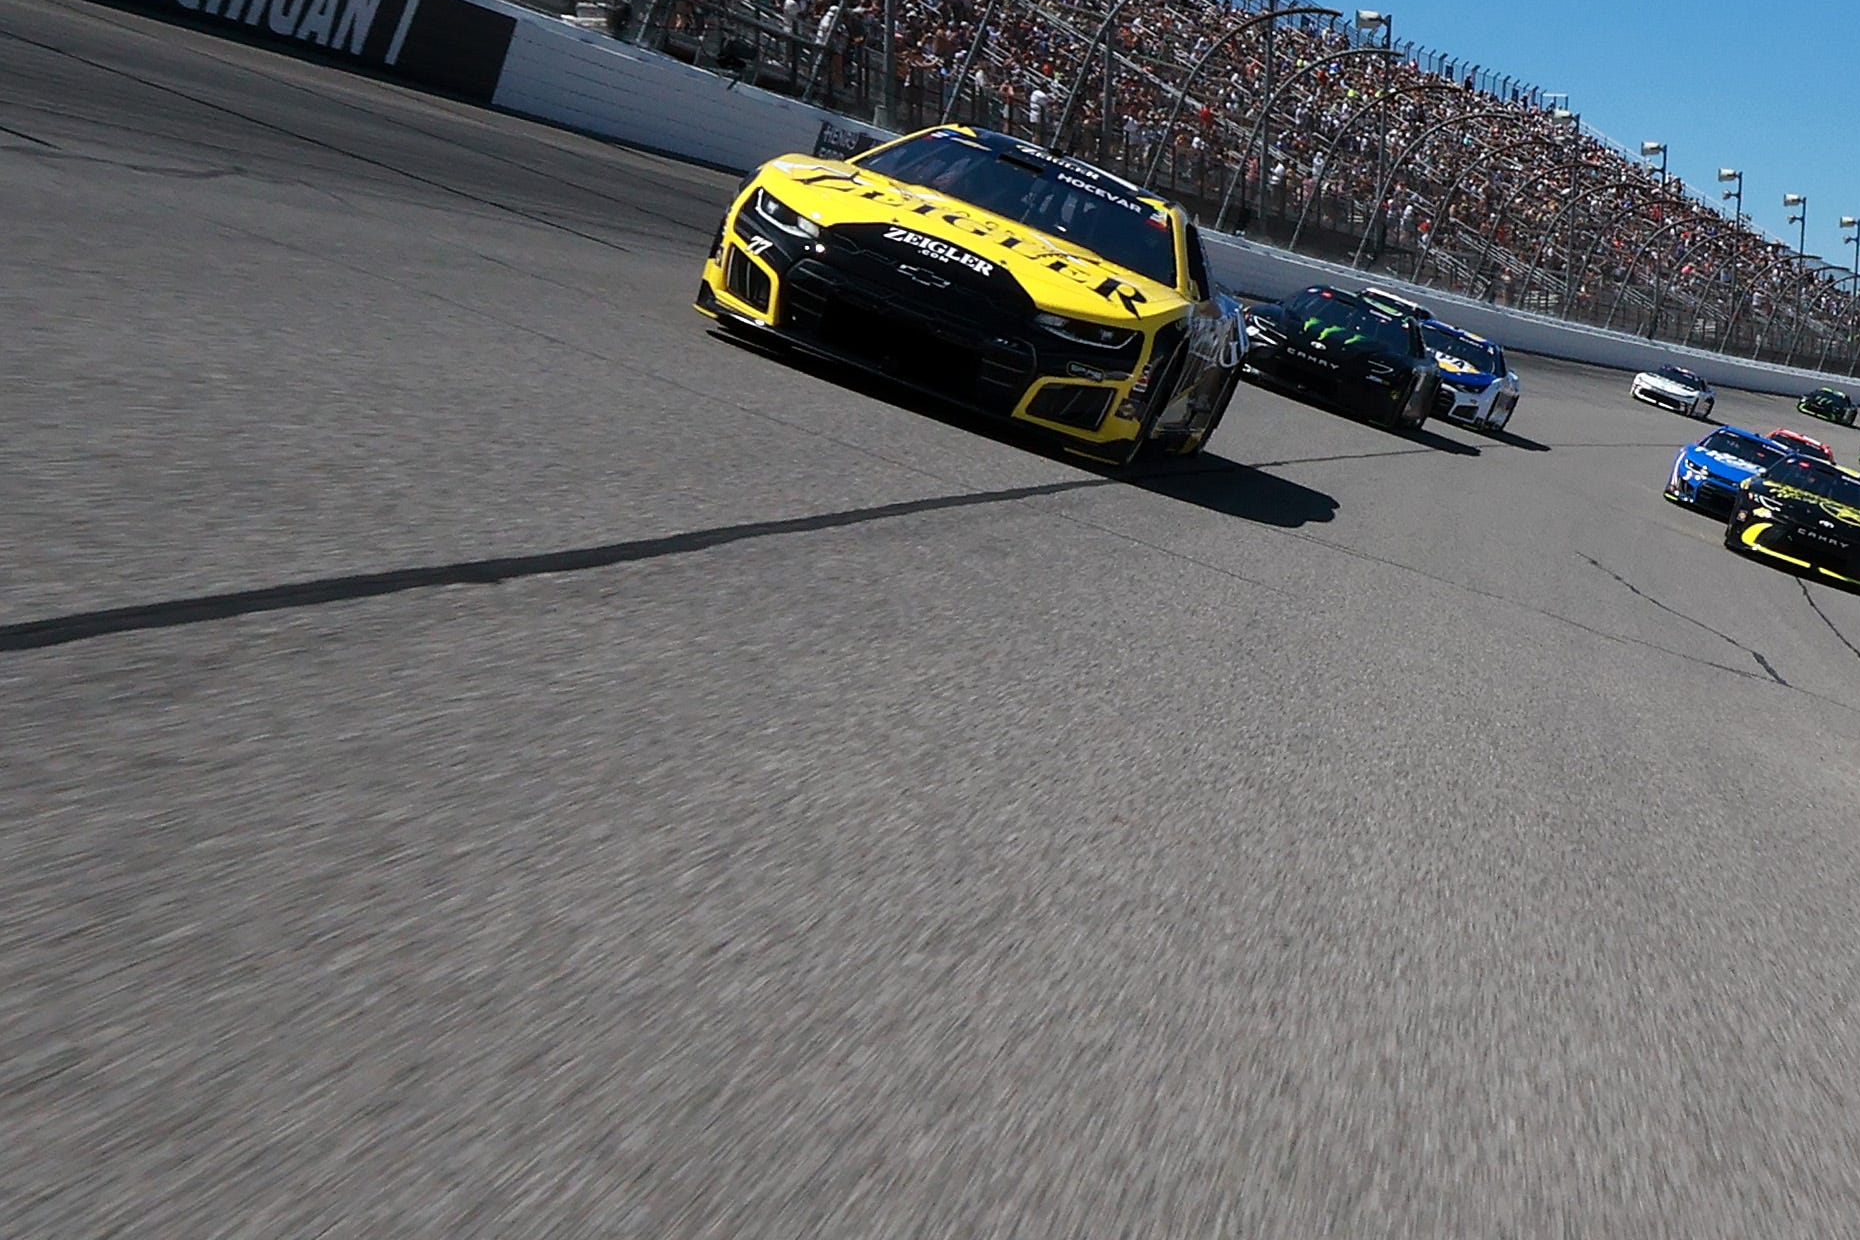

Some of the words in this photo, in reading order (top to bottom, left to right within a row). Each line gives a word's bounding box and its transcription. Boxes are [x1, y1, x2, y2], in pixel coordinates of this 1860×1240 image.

[1057, 172, 1142, 215] HOCEVAR
[745, 235, 774, 256] 77
[883, 226, 994, 278] ZEIGLER
[1286, 346, 1340, 371] CAMRY
[1797, 526, 1850, 549] CAMRY
